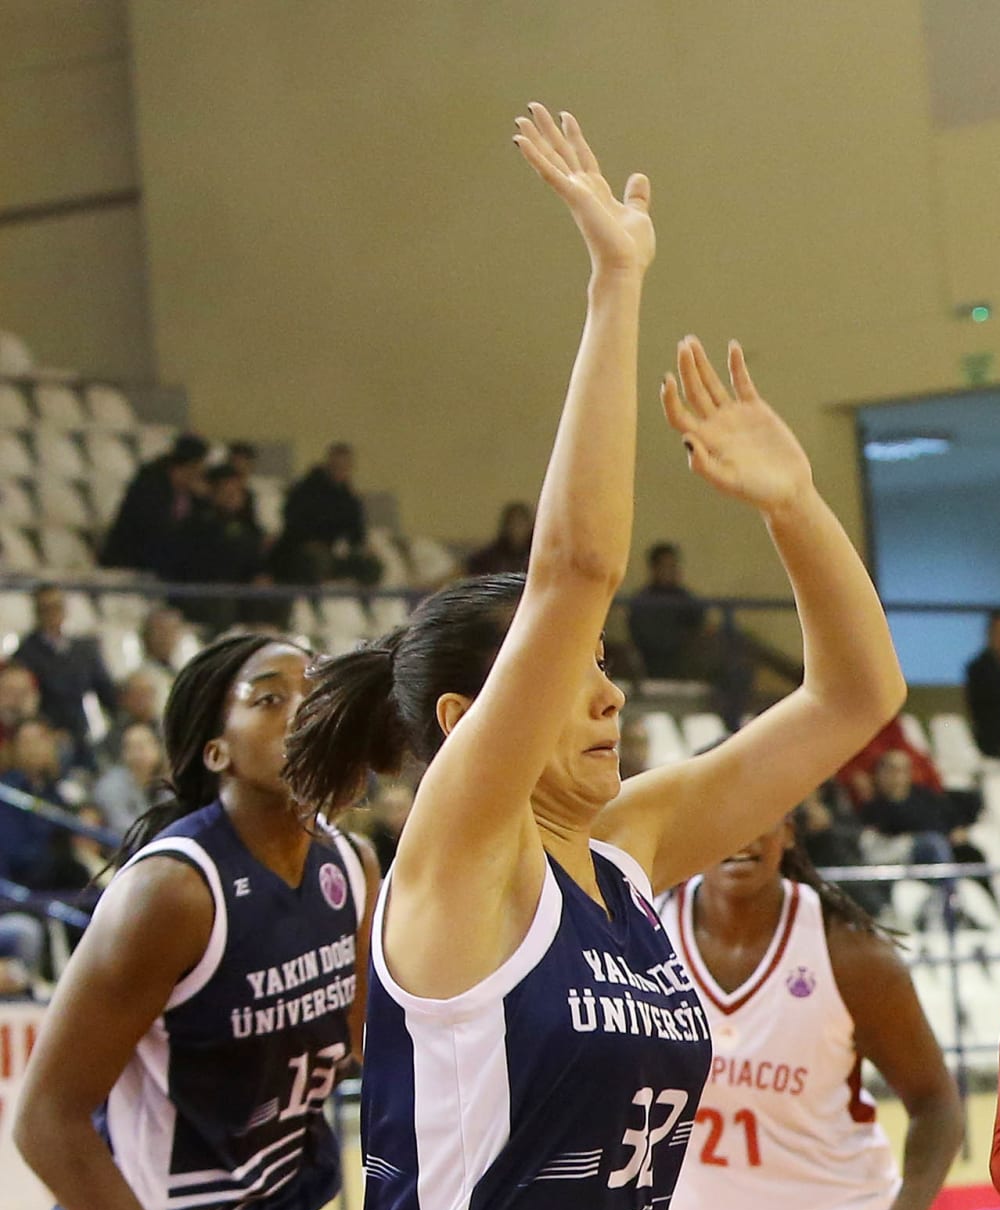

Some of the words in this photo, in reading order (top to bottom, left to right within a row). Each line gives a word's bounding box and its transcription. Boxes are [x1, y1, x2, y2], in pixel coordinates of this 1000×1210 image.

[246, 948, 319, 1000] YAKIN
[567, 988, 710, 1042] ÜNİVERSİT
[711, 1055, 809, 1096] PIACOS
[607, 1086, 689, 1189] 32
[694, 1106, 762, 1168] 21
